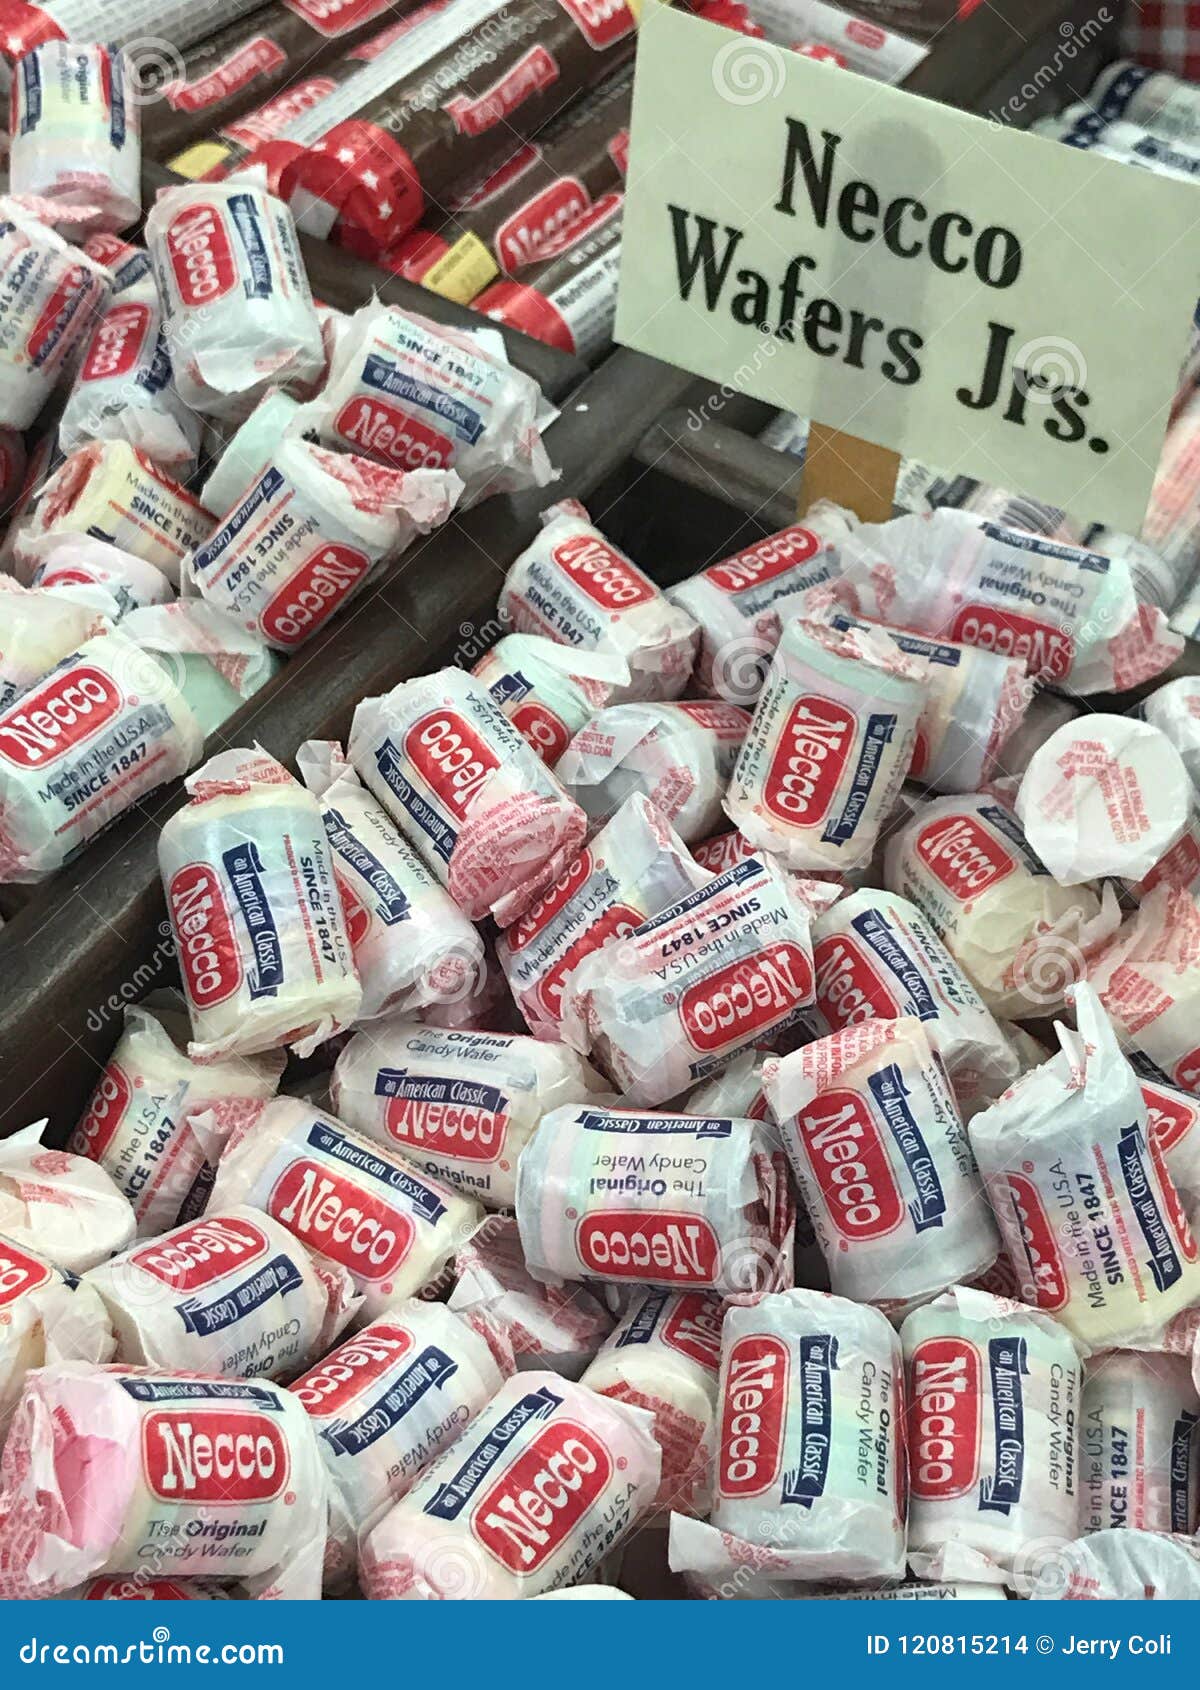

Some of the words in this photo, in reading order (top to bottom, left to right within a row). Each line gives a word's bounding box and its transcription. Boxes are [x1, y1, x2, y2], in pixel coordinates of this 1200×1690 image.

[773, 116, 1023, 289] Necco
[171, 211, 219, 298] Necco
[91, 311, 142, 375] Necco
[667, 204, 924, 386] Wafers
[956, 321, 1109, 455] Jrs.
[397, 334, 441, 362] SINCE
[447, 361, 483, 386] 1847
[382, 373, 432, 404] American
[435, 393, 471, 425] Classic
[126, 472, 159, 502] Made
[130, 496, 173, 532] SINCE
[257, 513, 294, 555] SINCE
[285, 516, 320, 552] Made
[226, 555, 257, 592] 1847
[256, 560, 278, 582] the
[275, 550, 289, 565] in
[528, 562, 552, 591] Made
[560, 542, 641, 602] Necco
[716, 532, 809, 588] Necco
[275, 552, 361, 636] Necco
[979, 576, 1046, 606] Original
[1034, 571, 1084, 598] Candy
[526, 586, 558, 620] SINCE
[556, 616, 584, 645] 1847
[0, 678, 108, 761] Necco
[751, 688, 773, 740] SINCE
[771, 677, 789, 718] Made
[38, 770, 81, 803] Made
[81, 761, 94, 775] in
[93, 746, 114, 768] the
[64, 772, 110, 812] SINCE
[111, 742, 147, 775] 1847
[383, 762, 411, 799] Classic
[737, 741, 754, 783] 1847
[776, 707, 848, 813] Necco
[856, 736, 883, 786] American
[363, 811, 396, 848] Candy
[410, 795, 449, 840] American
[840, 790, 864, 827] Classic
[232, 859, 248, 875] an
[328, 830, 372, 872] American
[370, 871, 402, 906] Classic
[921, 820, 998, 887] Necco
[233, 872, 266, 926] American
[300, 857, 322, 912] SINCE
[315, 917, 336, 964] 1847
[687, 868, 740, 906] American
[173, 877, 222, 994] Necco
[707, 897, 761, 933] SINCE
[724, 932, 741, 944] in
[744, 907, 789, 935] Made
[254, 931, 279, 974] Classic
[518, 944, 554, 980] Made
[552, 931, 567, 945] in
[564, 911, 586, 932] the
[661, 927, 705, 957] 1847
[698, 940, 724, 957] the
[908, 921, 942, 965] SINCE
[938, 968, 965, 1006] 1847
[866, 930, 907, 972] American
[903, 970, 930, 1003] Classic
[693, 950, 804, 1034] Necco
[406, 1038, 454, 1059] Candy
[456, 1046, 502, 1062] Wafer
[447, 1032, 514, 1049] Original
[396, 1080, 447, 1099] American
[450, 1082, 489, 1105] Classic
[881, 1081, 894, 1096] an
[73, 1078, 119, 1154] ecco
[144, 1116, 177, 1162] 1847
[597, 1117, 641, 1133] Classic
[647, 1118, 707, 1133] American
[882, 1098, 920, 1155] American
[113, 1165, 124, 1180] in
[120, 1138, 143, 1166] the
[320, 1134, 333, 1147] an
[331, 1142, 387, 1177] American
[389, 1169, 428, 1203] Classic
[426, 1161, 491, 1191] Original
[592, 1153, 645, 1172] Wafer
[649, 1153, 707, 1173] Candy
[802, 1104, 881, 1226] Necco
[912, 1158, 938, 1203] Classic
[1124, 1150, 1147, 1198] Classic
[590, 1176, 668, 1196] Original
[673, 1180, 706, 1196] The
[1075, 1174, 1105, 1222] 1847
[280, 1169, 396, 1265] Necco
[1140, 1200, 1168, 1261] American
[146, 1221, 257, 1276] Necco
[590, 1223, 706, 1276] Necco
[1075, 1240, 1091, 1258] in
[1096, 1225, 1124, 1286] SINCE
[237, 1268, 279, 1307] American
[1080, 1261, 1106, 1308] Made
[201, 1303, 238, 1329] Classic
[258, 1318, 301, 1351] Candy
[219, 1343, 263, 1373] Wafer
[298, 1334, 402, 1404] Necco
[425, 1357, 441, 1371] an
[999, 1349, 1014, 1365] an
[385, 1363, 432, 1412] American
[804, 1361, 824, 1426] American
[854, 1361, 876, 1430] Candy
[878, 1369, 890, 1403] The
[996, 1367, 1017, 1431] American
[1049, 1363, 1064, 1426] Candy
[349, 1408, 391, 1444] Classic
[426, 1405, 470, 1444] Candy
[727, 1354, 778, 1482] Necco
[916, 1357, 968, 1484] Necco
[158, 1422, 275, 1489] Necco
[385, 1442, 429, 1480] Wafer
[442, 1492, 458, 1509] an
[453, 1442, 501, 1497] American
[495, 1404, 535, 1443] Classic
[801, 1432, 827, 1482] Classic
[856, 1428, 874, 1487] Wafer
[875, 1408, 890, 1497] Original
[999, 1440, 1022, 1488] Classic
[1049, 1426, 1064, 1490] Wafer
[1064, 1409, 1076, 1497] Original
[1111, 1425, 1128, 1479] 1847
[1086, 1462, 1103, 1490] the
[483, 1438, 597, 1565] Necco
[185, 1519, 267, 1540] Original
[199, 1543, 256, 1557] Wafer
[582, 1524, 604, 1549] the
[597, 1508, 630, 1552] 1847
